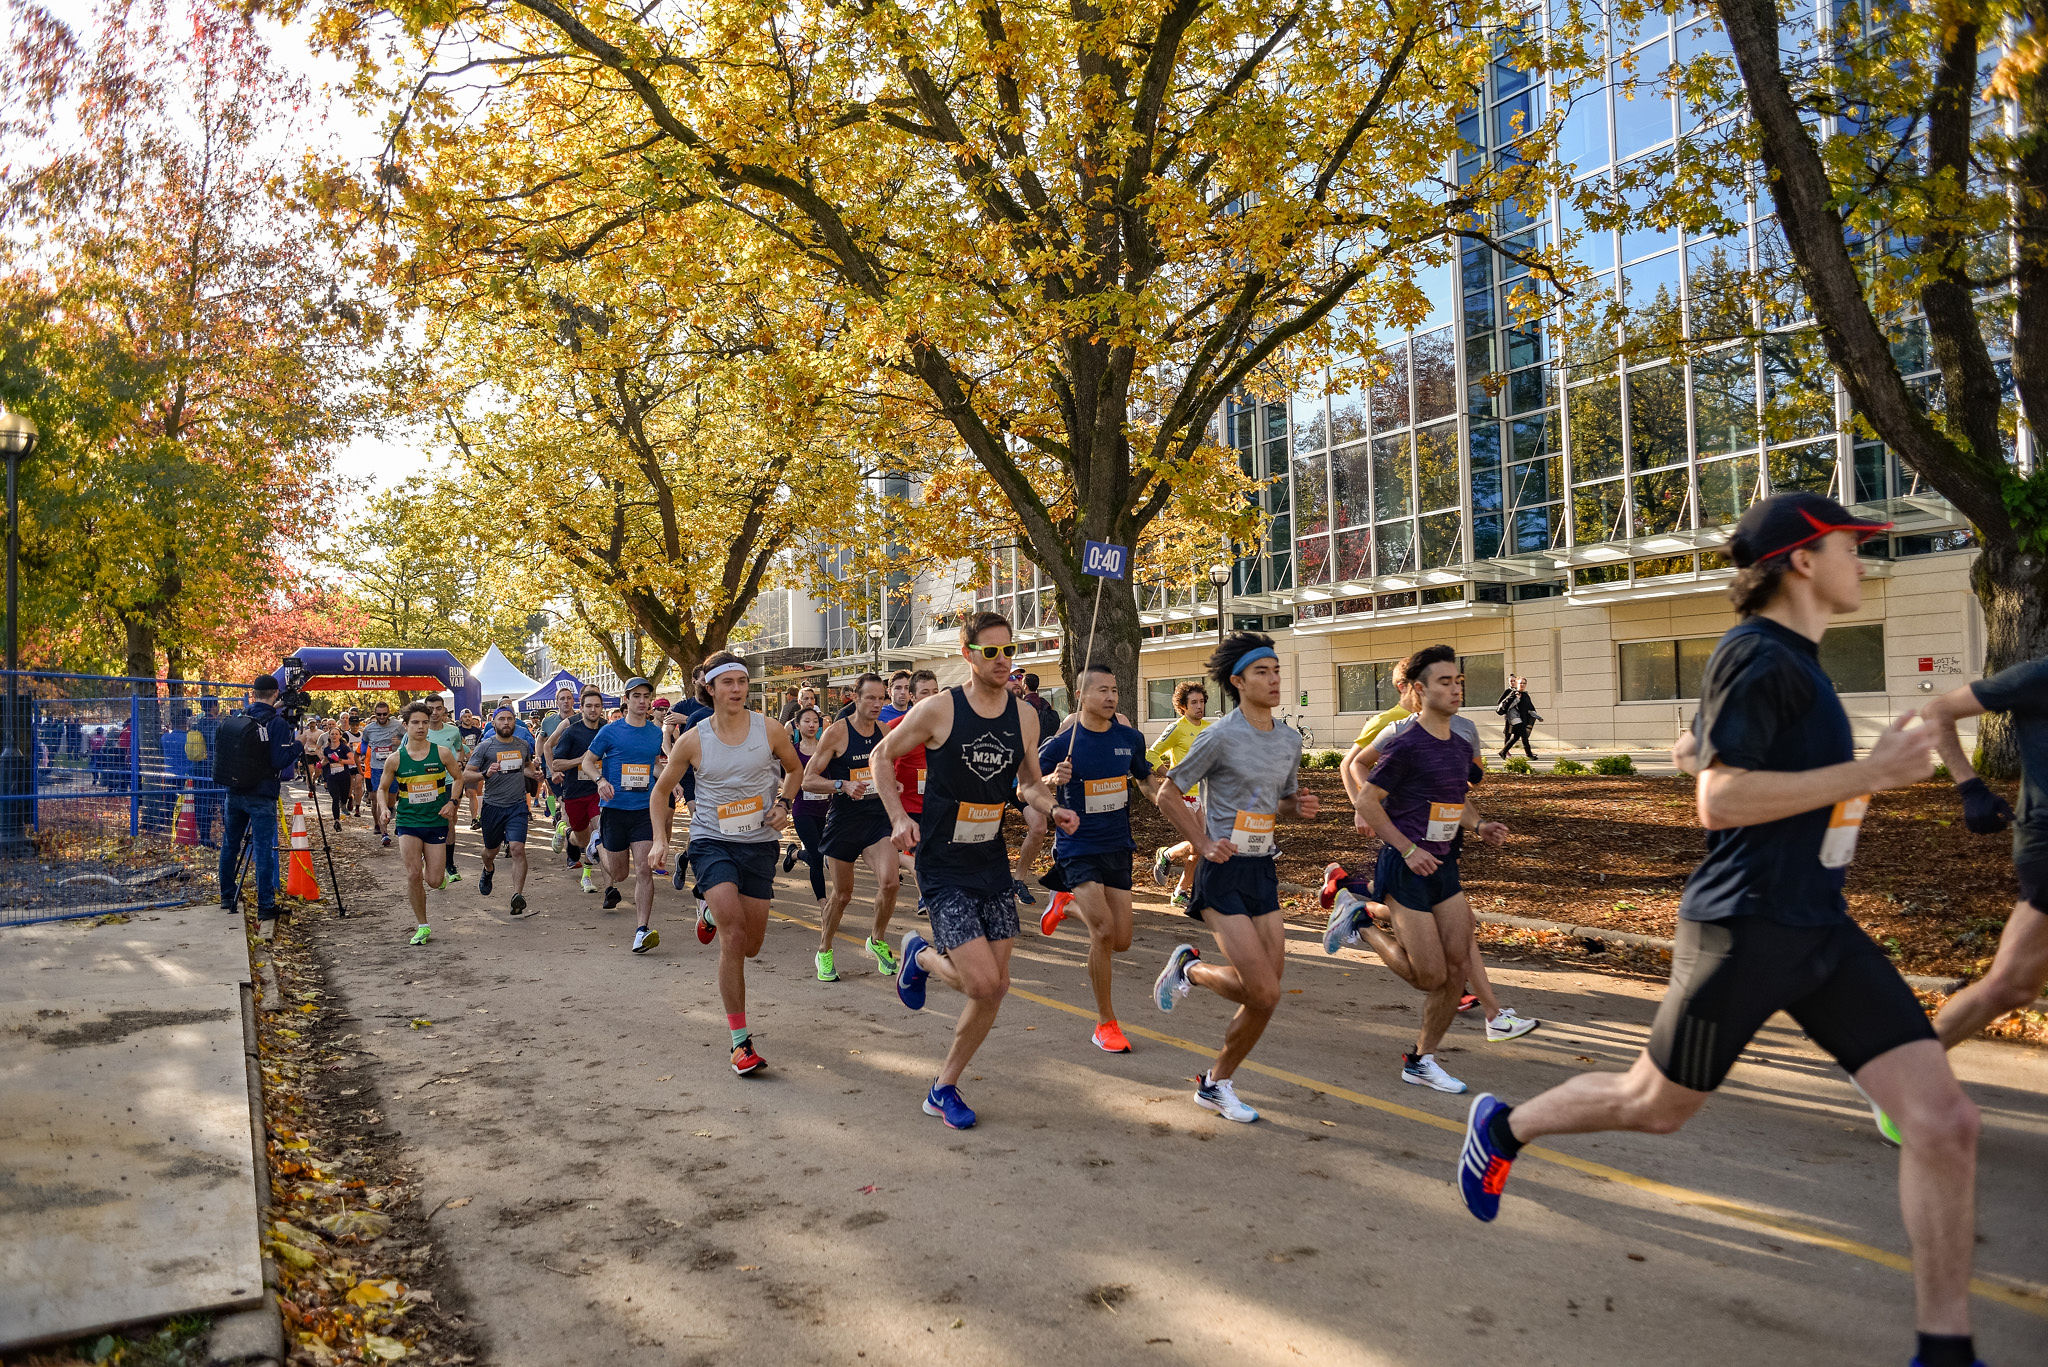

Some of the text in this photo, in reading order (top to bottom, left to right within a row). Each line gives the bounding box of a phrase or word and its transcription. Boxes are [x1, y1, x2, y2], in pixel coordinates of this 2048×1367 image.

[1089, 546, 1120, 573] 0:40
[343, 652, 404, 672] START
[449, 666, 464, 677] RUN
[450, 677, 464, 688] VAN
[972, 751, 1003, 765] M2M
